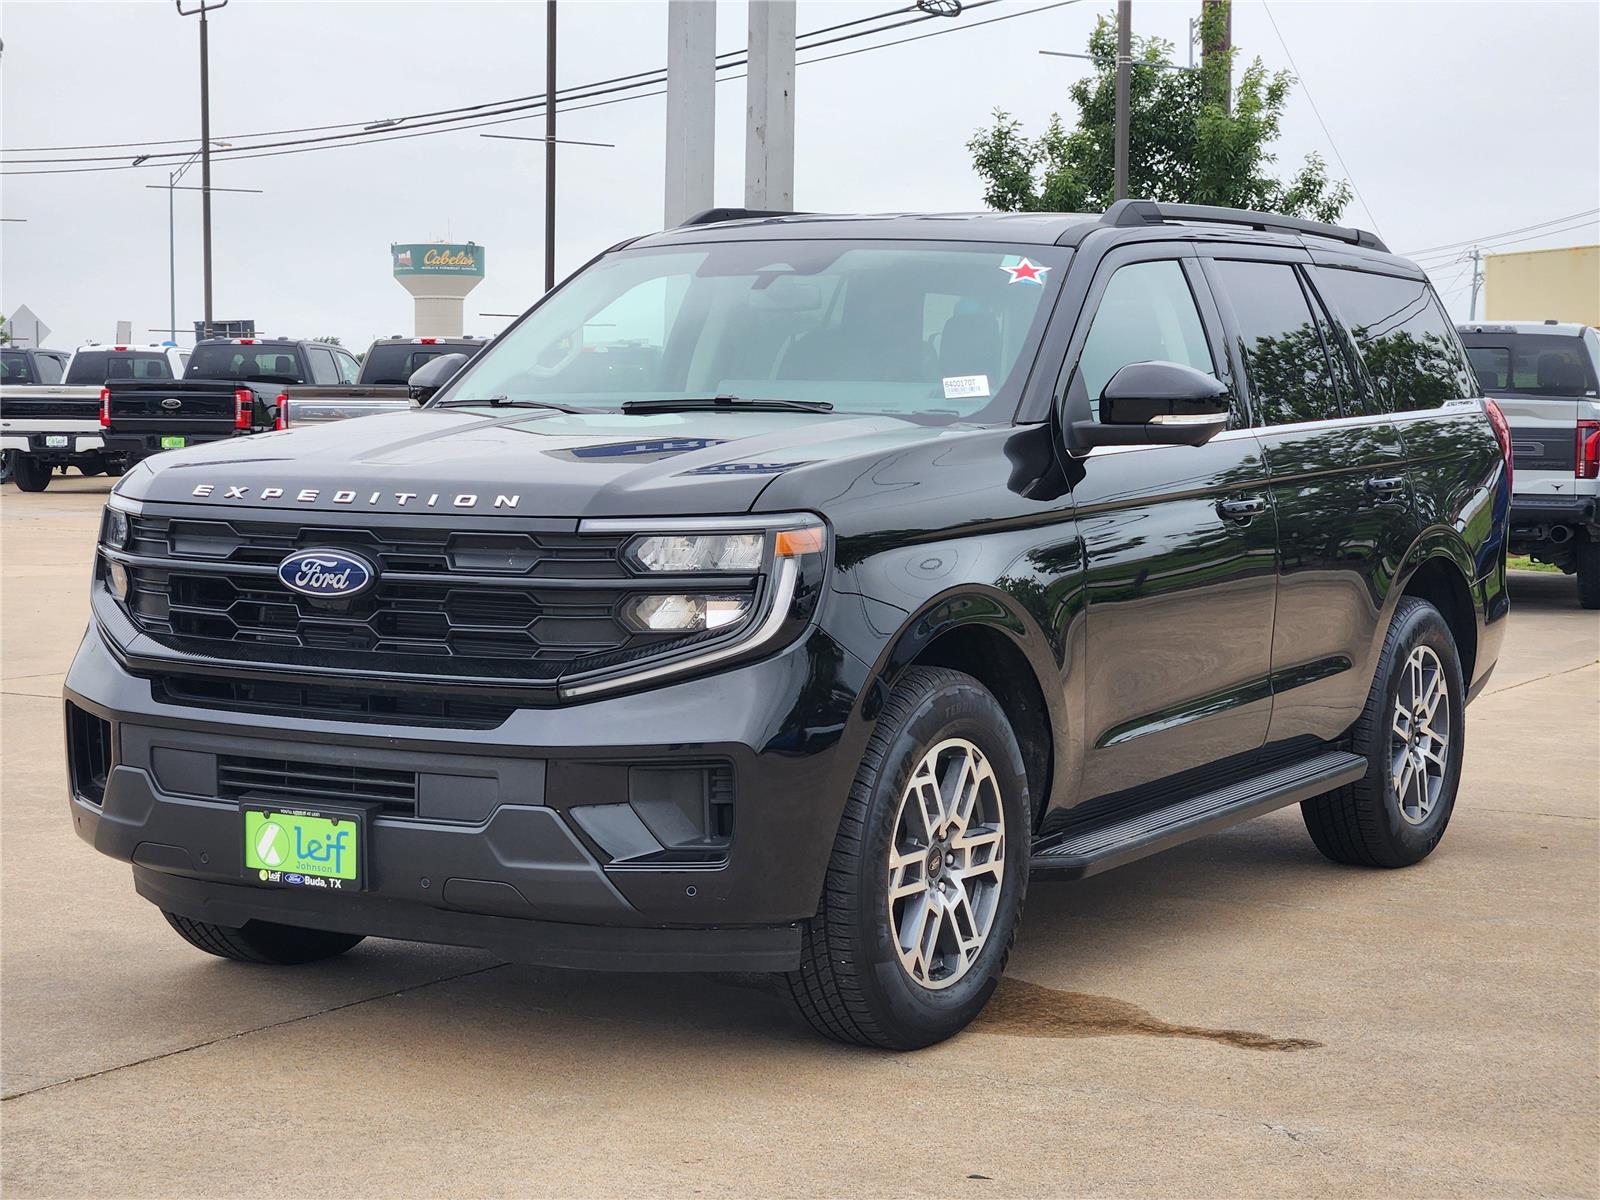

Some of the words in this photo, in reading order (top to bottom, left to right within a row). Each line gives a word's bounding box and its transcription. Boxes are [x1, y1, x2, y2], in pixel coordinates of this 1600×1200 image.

[192, 484, 521, 508] EXPEDITION
[295, 558, 351, 590] Ford
[294, 826, 349, 874] leif
[268, 870, 282, 882] leif
[296, 861, 333, 873] Johnson
[304, 876, 328, 888] Buda,
[329, 879, 342, 889] TX
